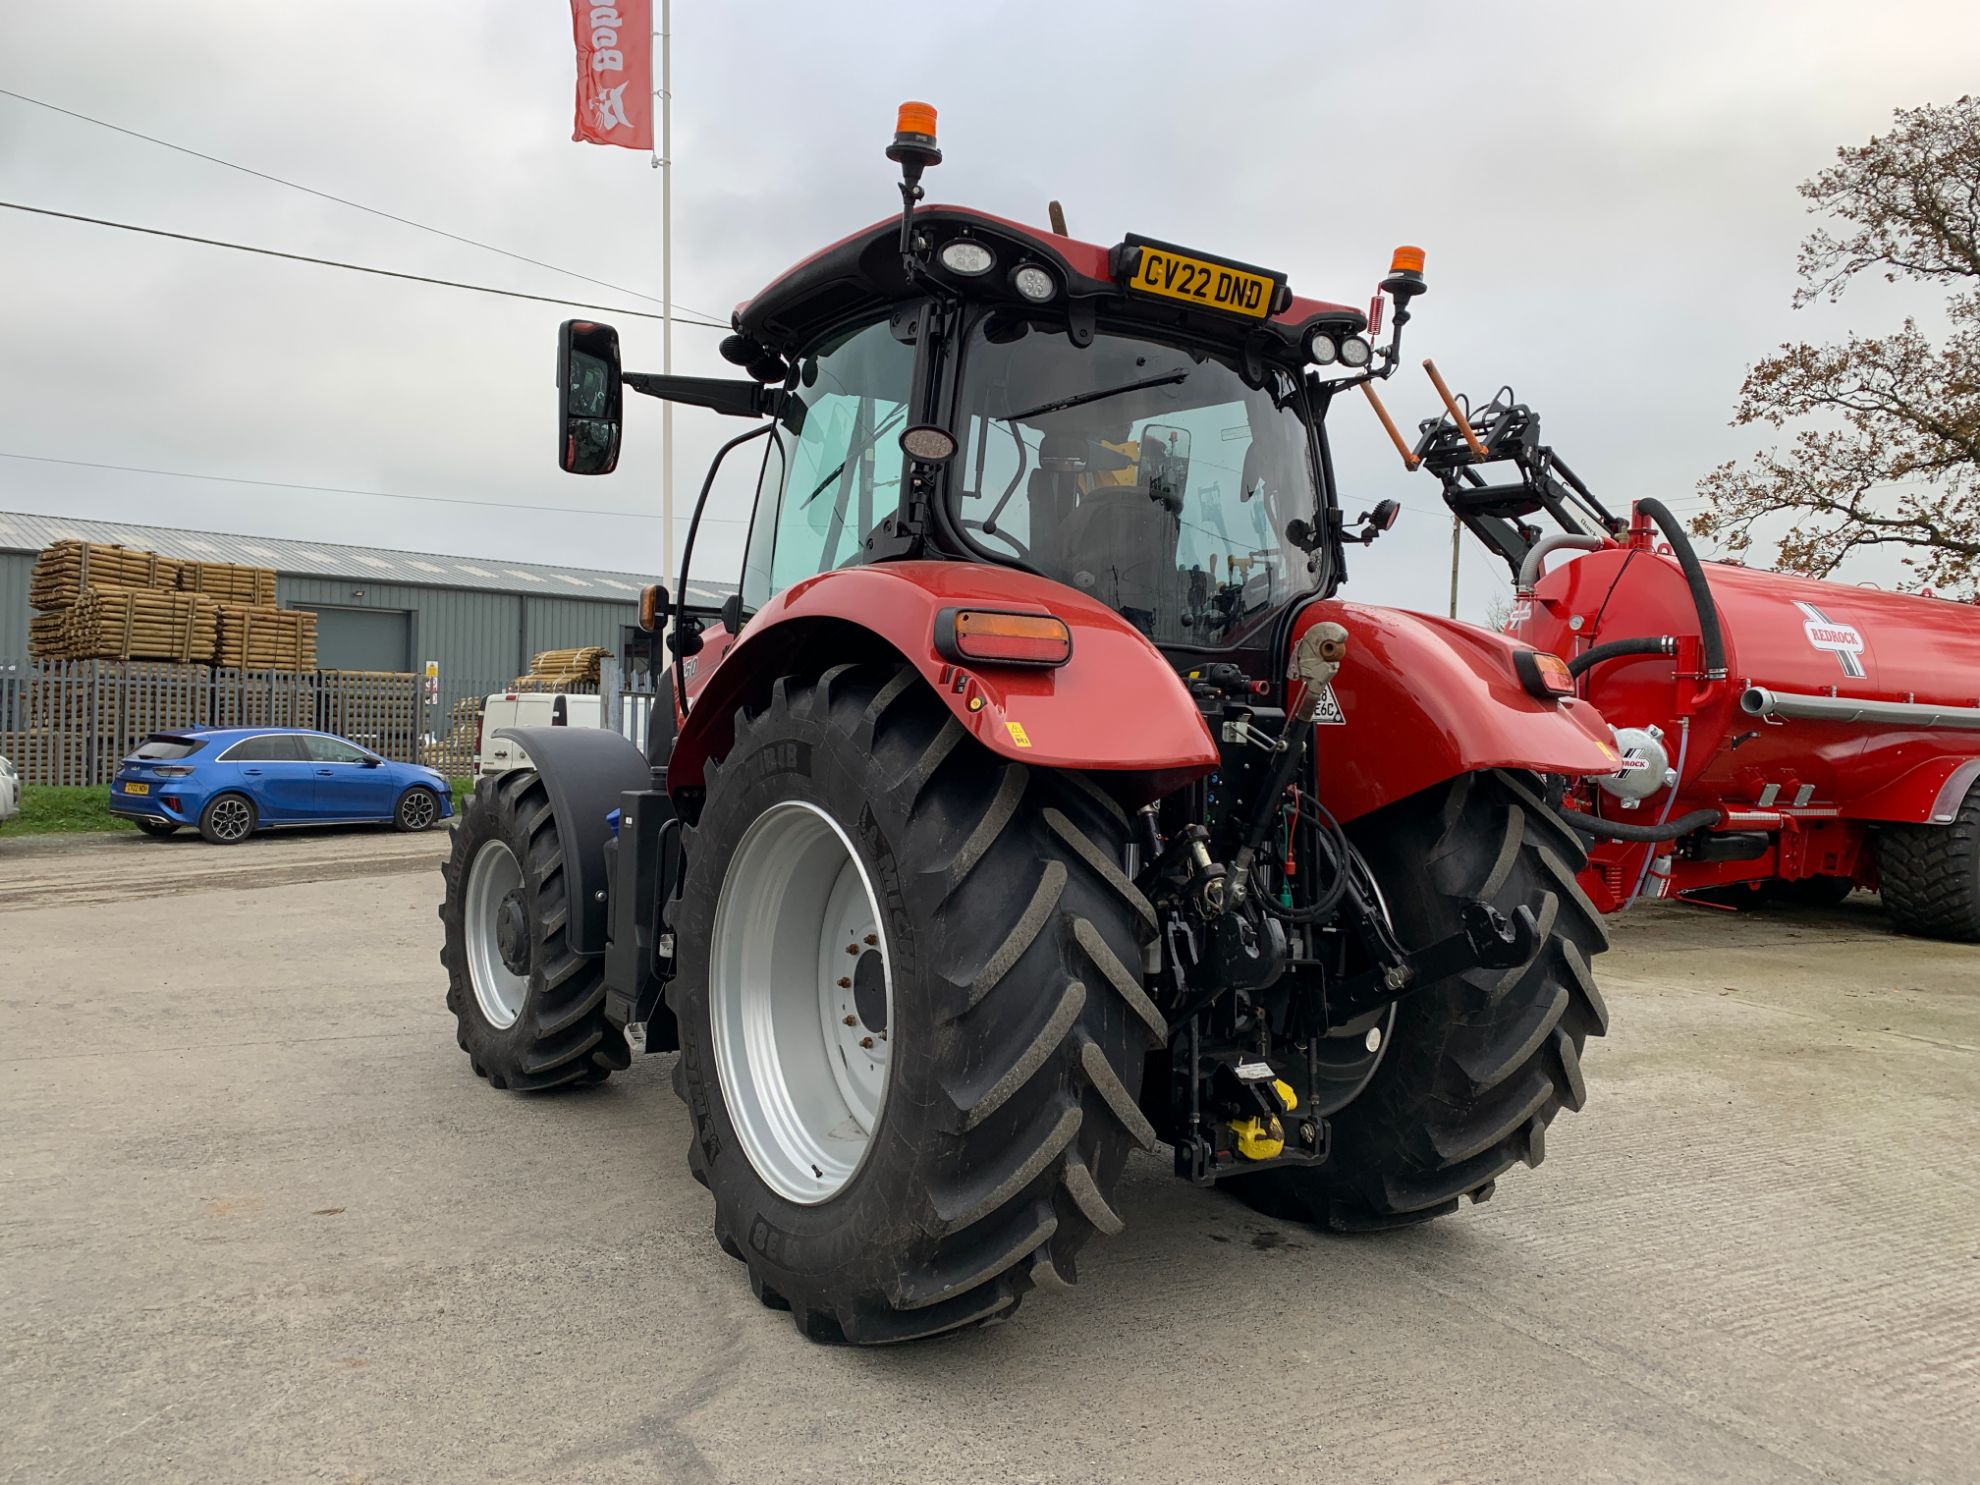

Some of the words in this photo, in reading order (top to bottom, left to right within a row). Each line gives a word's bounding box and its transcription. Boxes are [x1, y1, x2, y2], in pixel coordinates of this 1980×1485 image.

[1145, 255, 1212, 298] CV22
[1215, 272, 1263, 309] DND
[1811, 628, 1858, 645] REDROCK
